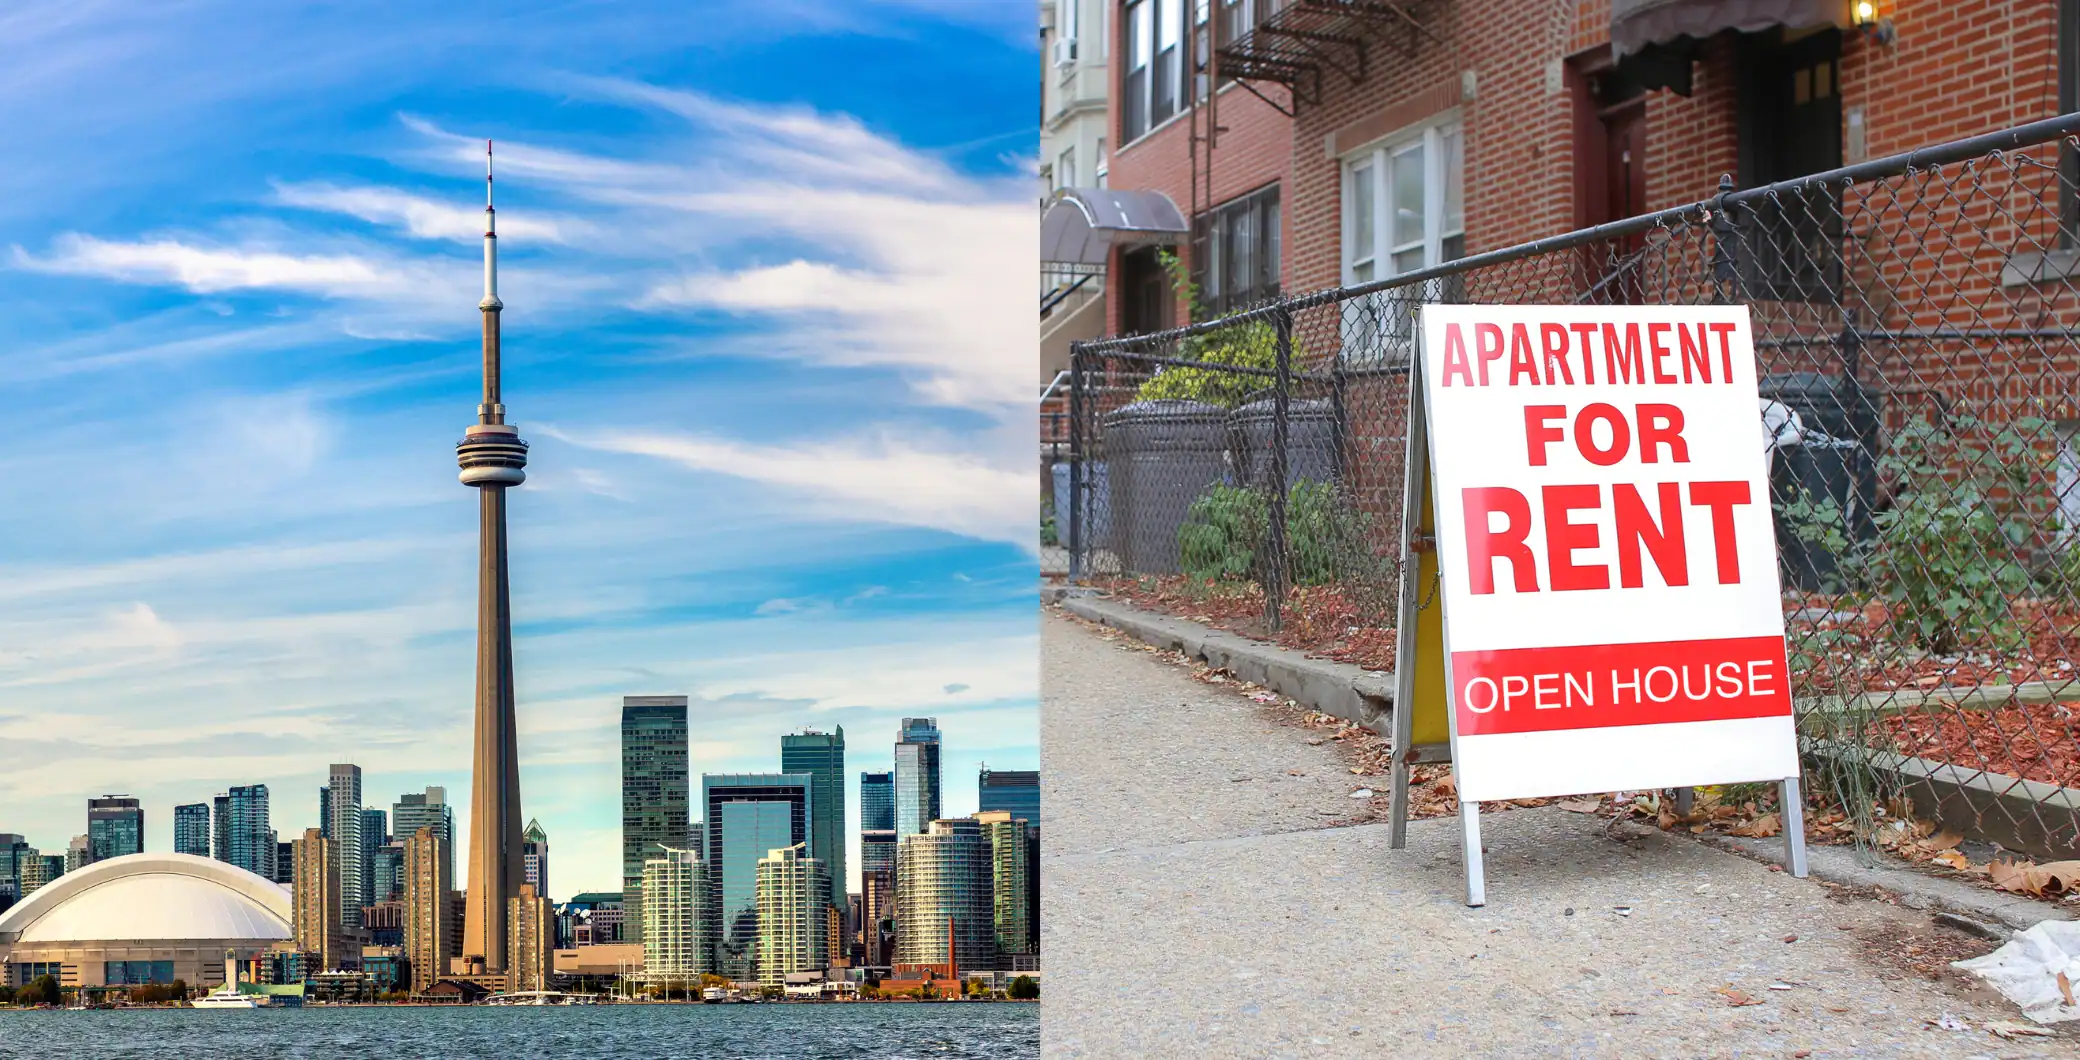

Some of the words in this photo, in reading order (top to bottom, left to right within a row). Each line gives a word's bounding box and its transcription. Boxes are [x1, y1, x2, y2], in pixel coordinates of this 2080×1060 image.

[1442, 323, 1736, 387] APARTMENT
[1524, 402, 1690, 467] FOR
[1462, 481, 1752, 595] RENT
[1463, 672, 1594, 714] OPEN
[1611, 659, 1776, 705] HOUSE
